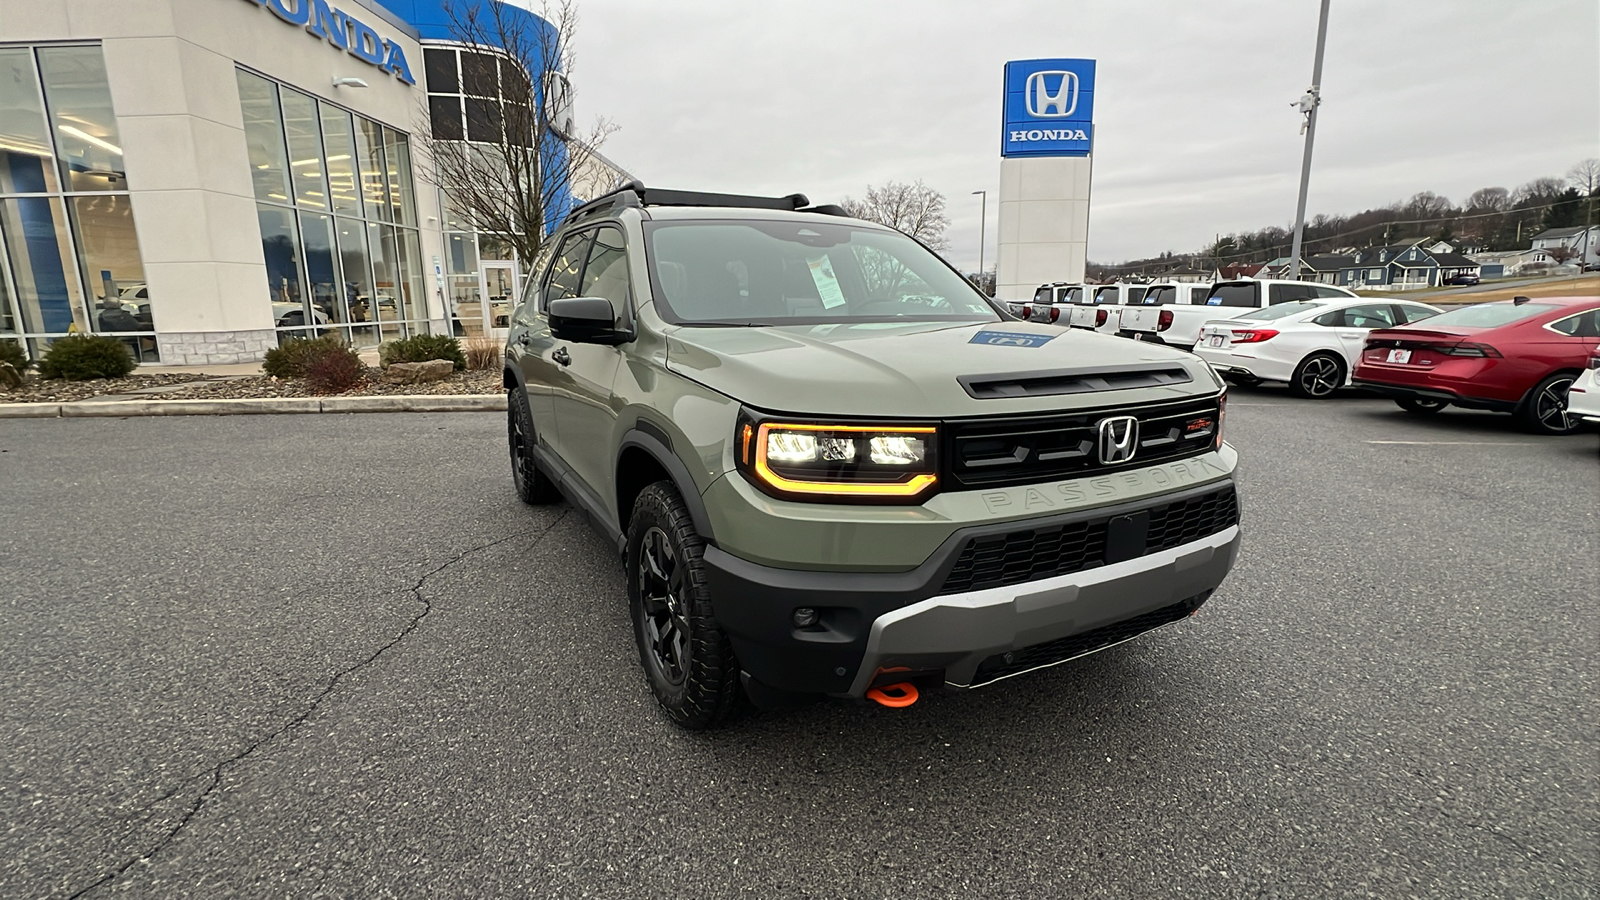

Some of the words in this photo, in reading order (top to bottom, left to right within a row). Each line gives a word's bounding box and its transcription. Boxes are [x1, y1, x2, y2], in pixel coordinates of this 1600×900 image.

[243, 0, 416, 86] ONDA
[1009, 129, 1089, 142] HONDA
[981, 457, 1227, 514] PASSPORT
